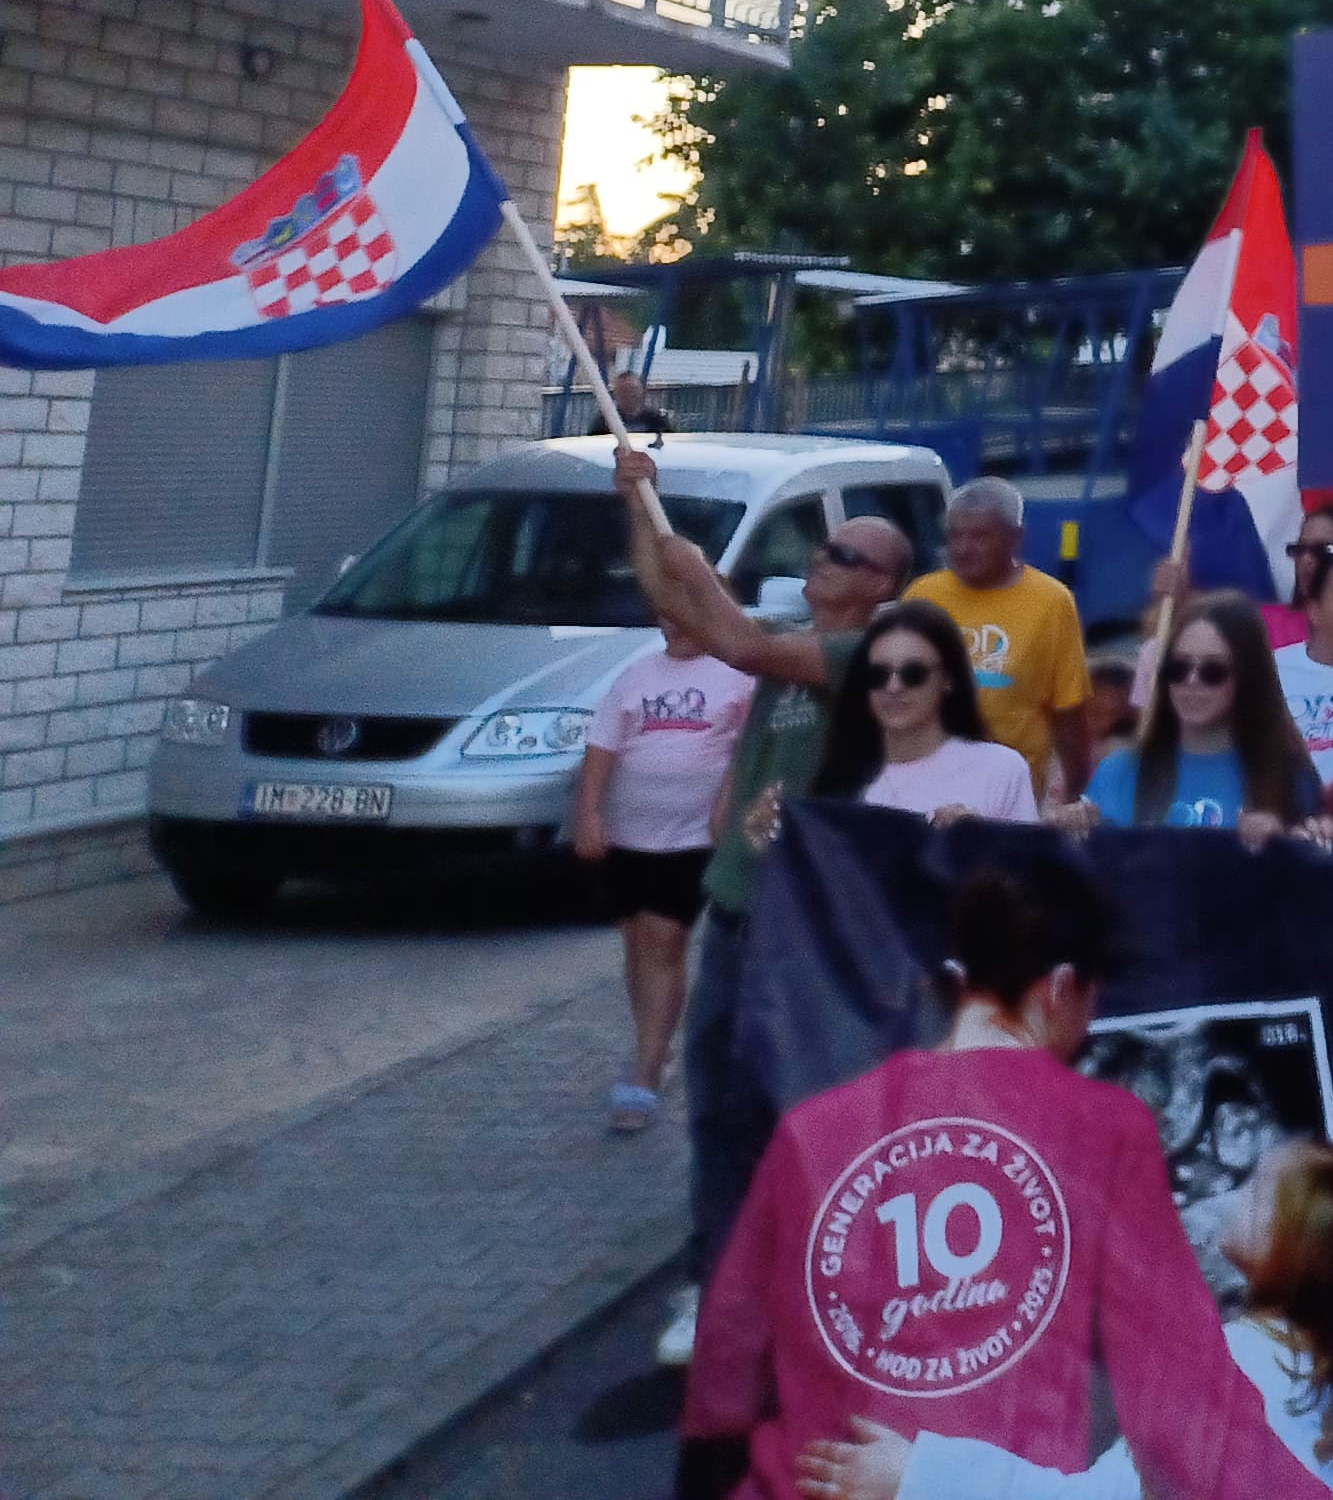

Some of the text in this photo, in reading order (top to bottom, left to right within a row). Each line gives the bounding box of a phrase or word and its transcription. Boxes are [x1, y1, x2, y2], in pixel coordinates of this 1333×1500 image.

[820, 1132, 1057, 1278] GENERACIJA ZA ŽIVOT
[874, 1181, 1003, 1289] 10
